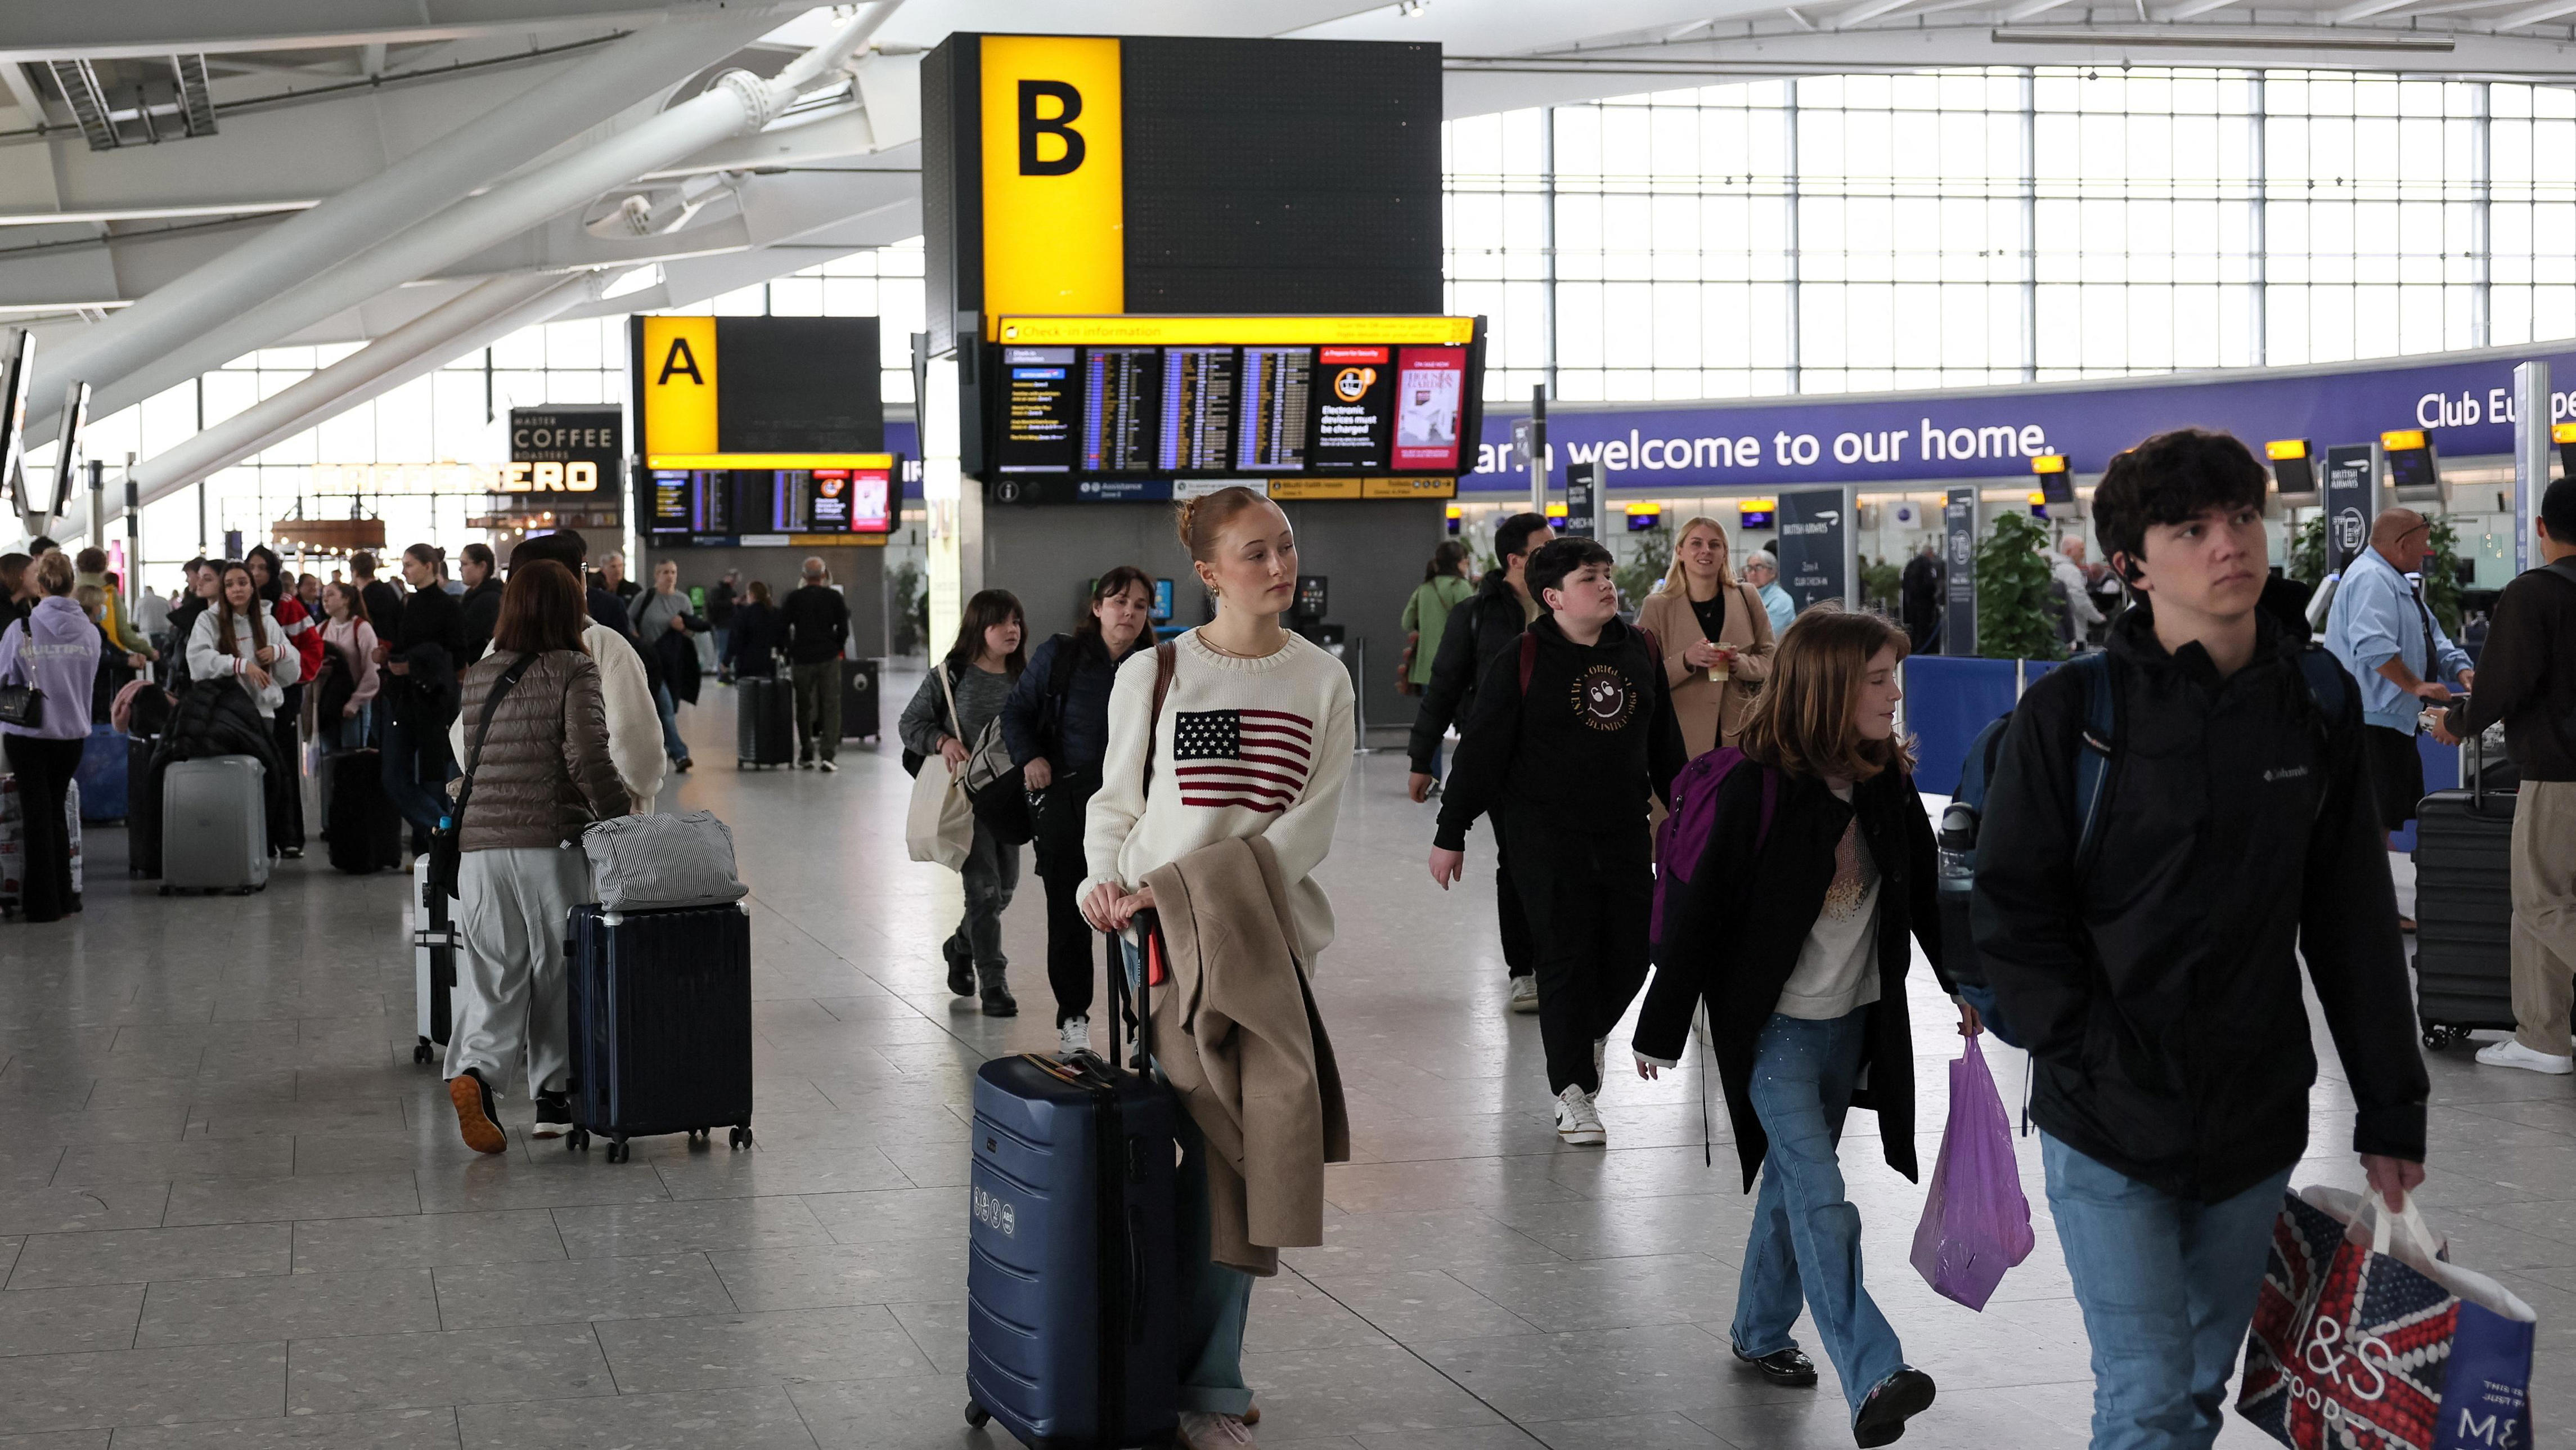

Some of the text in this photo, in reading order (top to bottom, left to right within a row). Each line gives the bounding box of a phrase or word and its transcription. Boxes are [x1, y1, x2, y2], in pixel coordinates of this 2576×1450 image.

[1018, 79, 1086, 176] B
[1084, 326, 1161, 337] information
[658, 338, 704, 385] A
[2417, 391, 2481, 429] Club
[513, 429, 612, 448] COFFEE
[1566, 429, 1761, 471] welcome
[1773, 431, 1820, 466] to
[1833, 430, 1909, 464] our
[1921, 417, 2056, 461] home.
[469, 461, 598, 492] NERO
[2331, 469, 2358, 479] BRITISH
[1101, 482, 1143, 491] Assistance
[2330, 479, 2358, 490] AIRWAYS
[1783, 523, 1805, 535] BRITISH
[1002, 1210, 1013, 1222] ABS
[2281, 1366, 2340, 1420] FOOD
